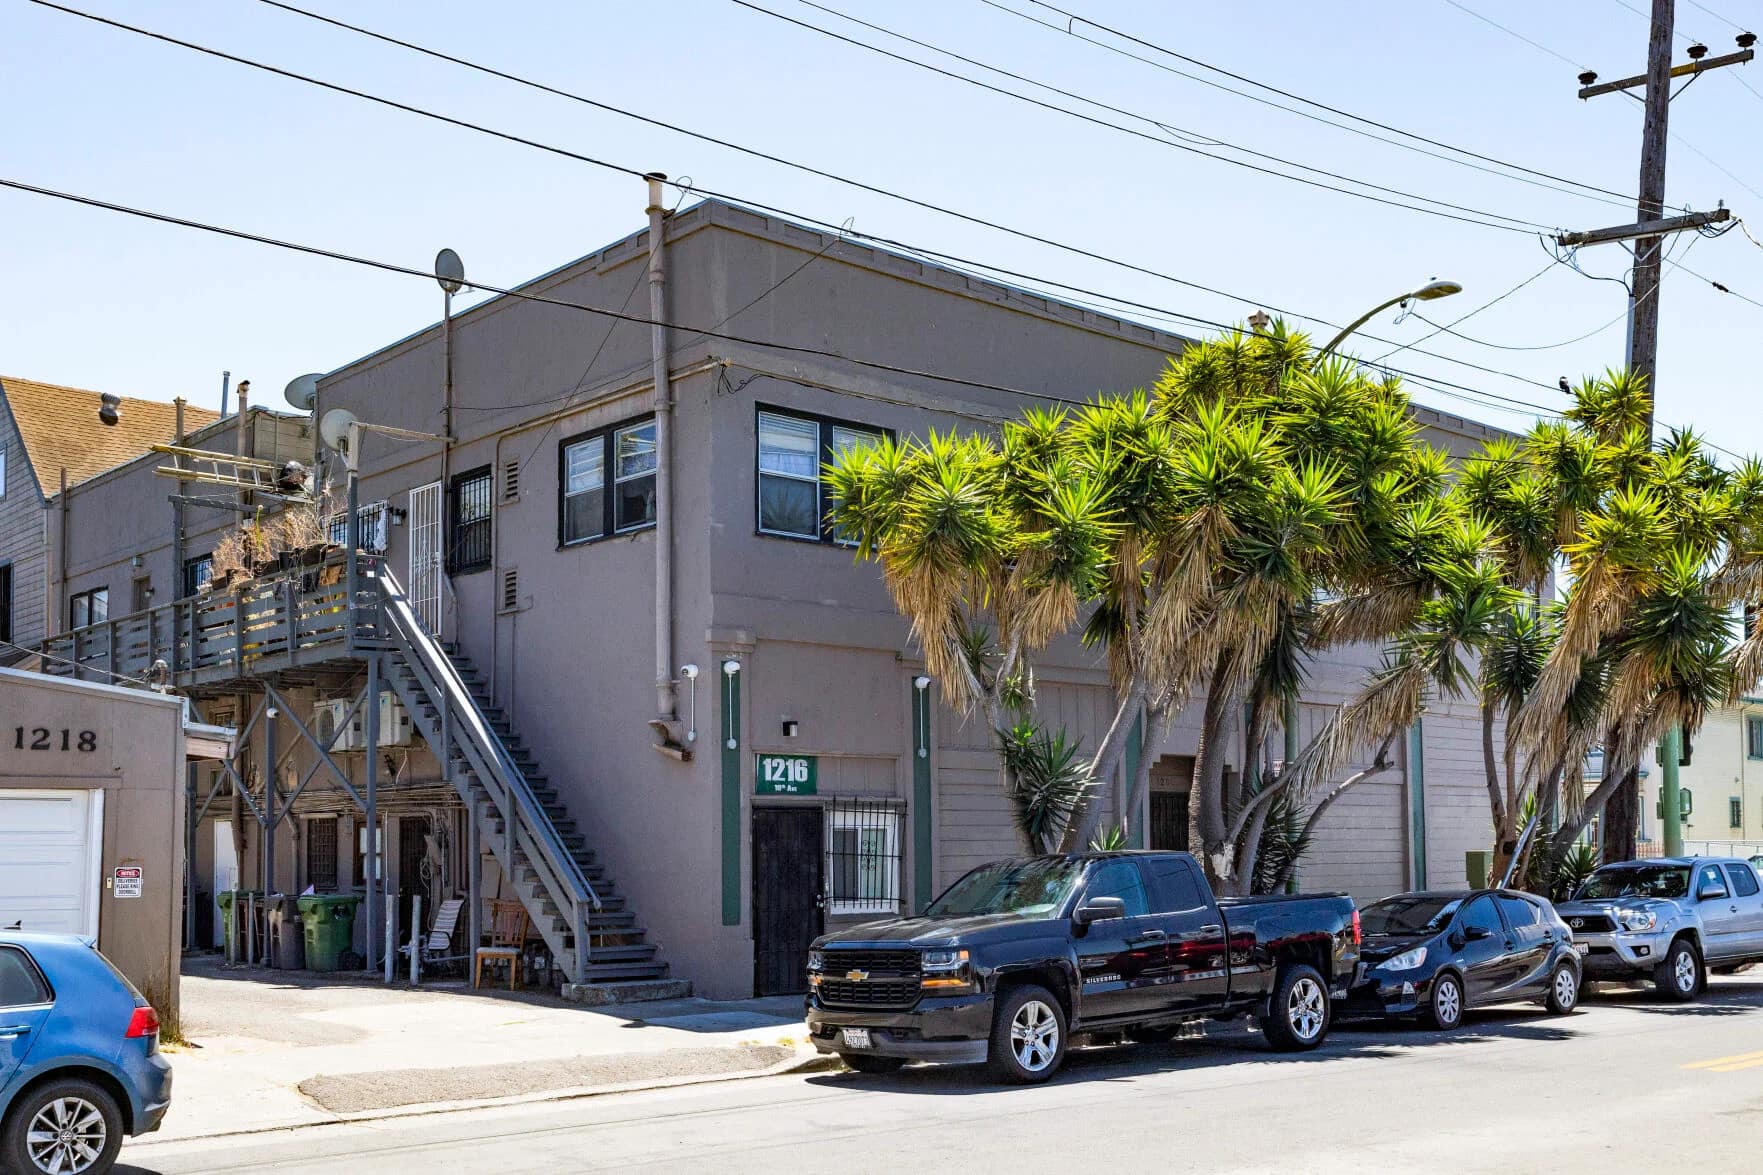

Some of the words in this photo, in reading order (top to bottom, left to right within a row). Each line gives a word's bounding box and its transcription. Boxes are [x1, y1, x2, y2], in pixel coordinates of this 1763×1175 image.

[14, 726, 97, 752] 1218
[763, 758, 808, 781] 1216
[1086, 974, 1121, 984] SILVERADO
